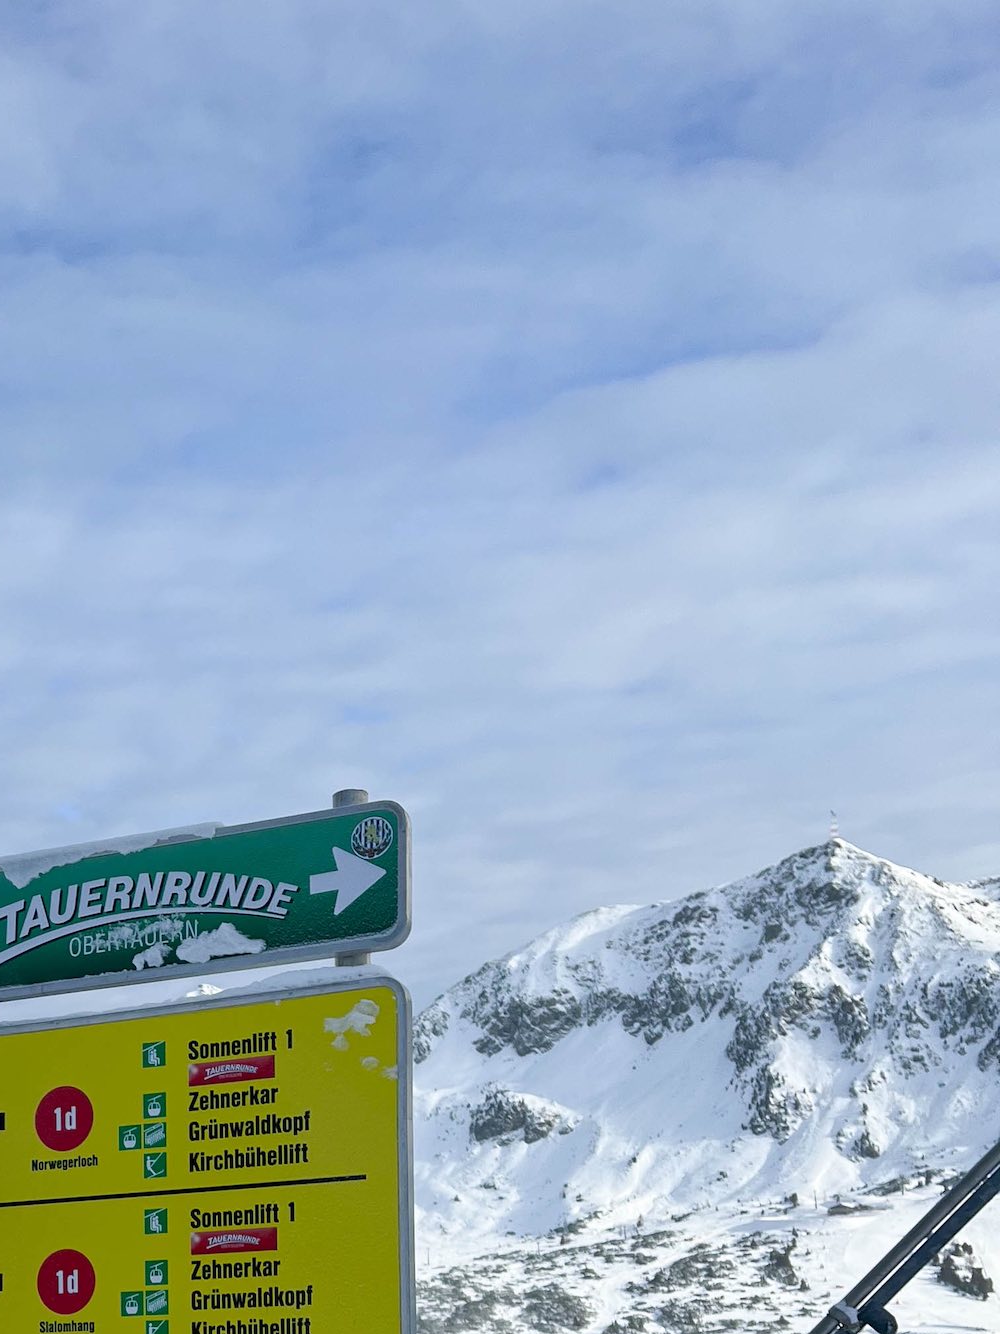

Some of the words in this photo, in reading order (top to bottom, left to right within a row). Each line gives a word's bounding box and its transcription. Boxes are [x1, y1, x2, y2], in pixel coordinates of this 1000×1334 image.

[188, 1031, 277, 1060] Sonnenlift
[285, 1029, 293, 1049] 1
[205, 1064, 258, 1076] TAUERNRUNDE
[188, 1085, 279, 1111] Zehnerkar
[54, 1106, 76, 1132] 1d
[188, 1111, 310, 1142] Grünwaldkopf
[31, 1154, 98, 1172] Norwegerloch
[188, 1143, 309, 1172] Kirchbühellift
[190, 1205, 279, 1229] Sonnenlift
[287, 1202, 295, 1222] 1
[207, 1234, 261, 1245] TAUERNRUNDE
[55, 1269, 79, 1294] 1d
[191, 1258, 281, 1281] Zehnerkar
[191, 1285, 313, 1311] Grünwaldkopf
[39, 1319, 95, 1334] Slalomhang
